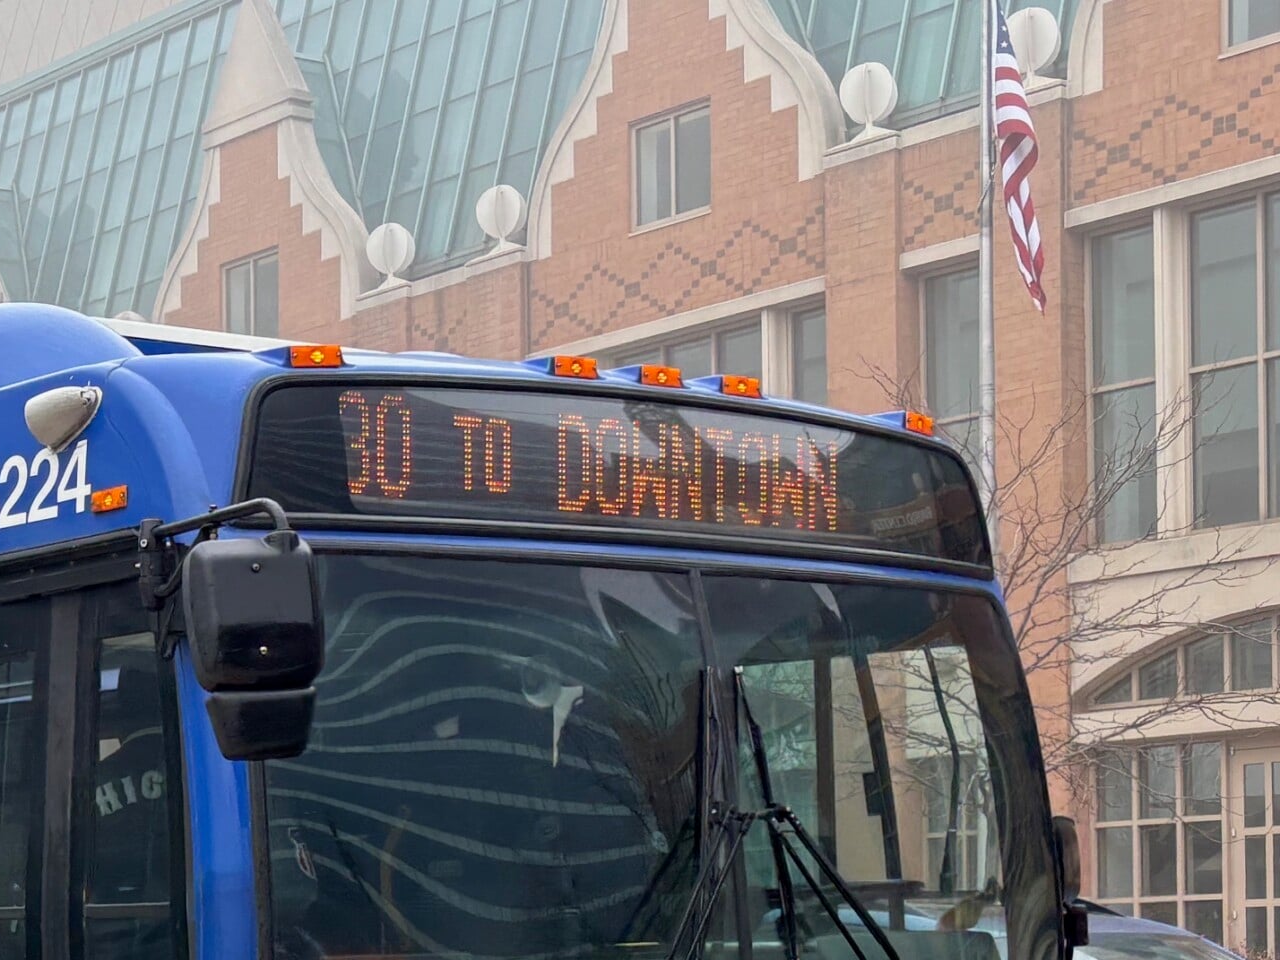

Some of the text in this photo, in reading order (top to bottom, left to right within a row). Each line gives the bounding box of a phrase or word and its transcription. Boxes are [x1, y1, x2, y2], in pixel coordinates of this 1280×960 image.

[338, 390, 838, 532] 30 TO DOWNTOWN
